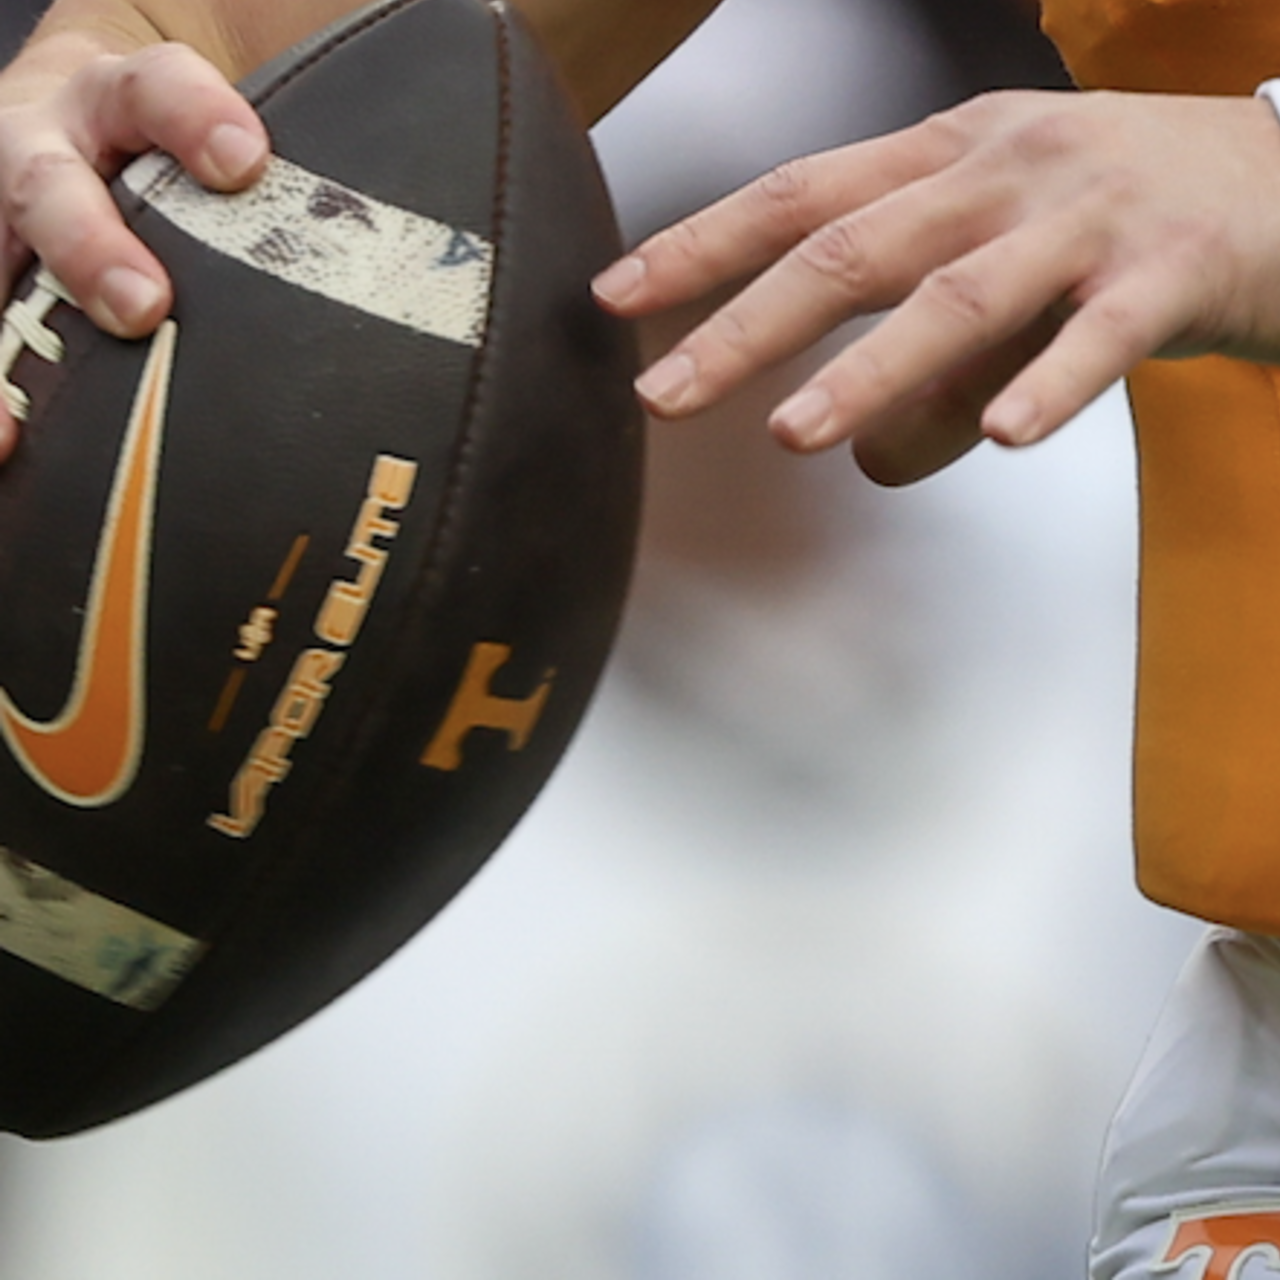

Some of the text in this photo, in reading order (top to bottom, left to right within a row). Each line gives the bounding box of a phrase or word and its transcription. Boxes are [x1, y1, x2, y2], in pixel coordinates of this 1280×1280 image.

[206, 454, 418, 838] VAPOR ELITE
[418, 641, 556, 771] T
